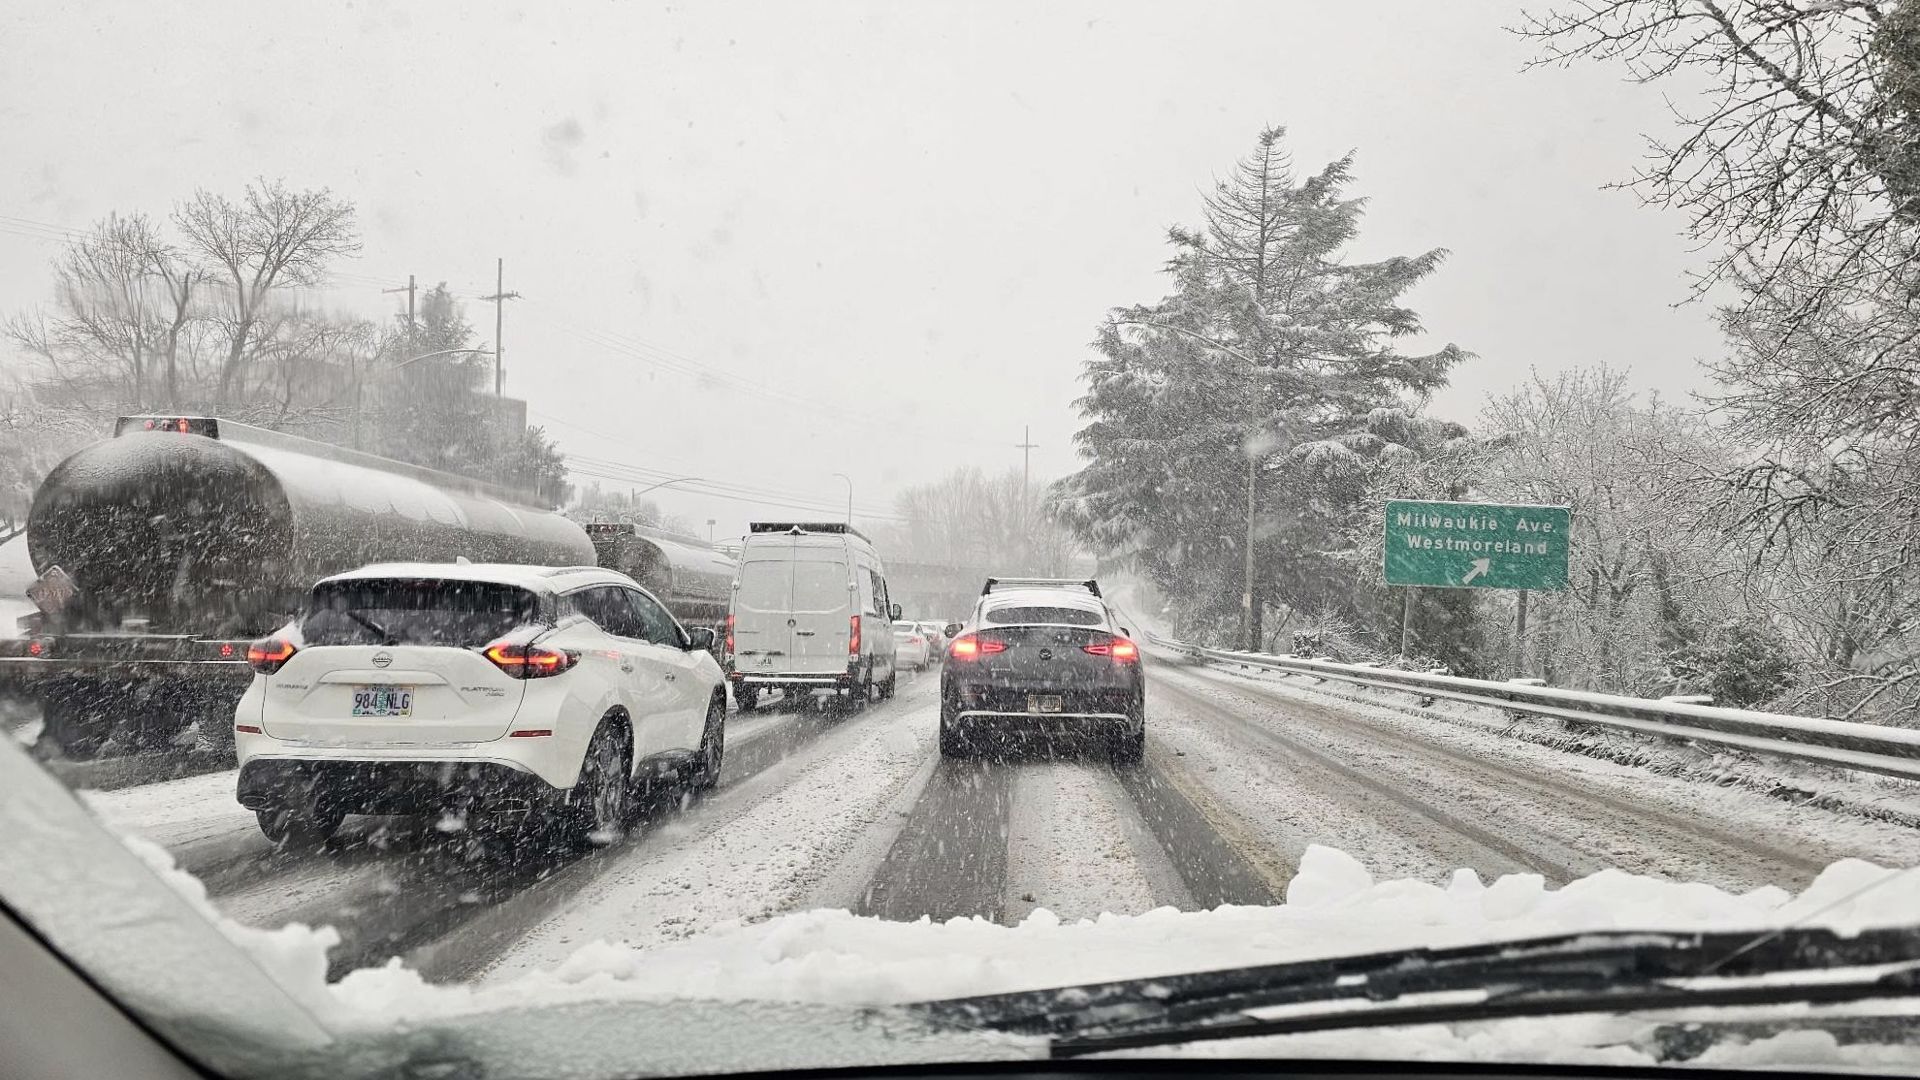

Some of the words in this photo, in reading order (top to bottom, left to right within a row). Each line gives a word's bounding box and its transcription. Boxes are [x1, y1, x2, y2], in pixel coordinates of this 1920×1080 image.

[1397, 511, 1498, 531] Milwaukie
[1515, 517, 1556, 534] Ave.
[1407, 534, 1548, 555] Westmoreland
[355, 693, 378, 709] 984
[386, 693, 410, 710] NLG
